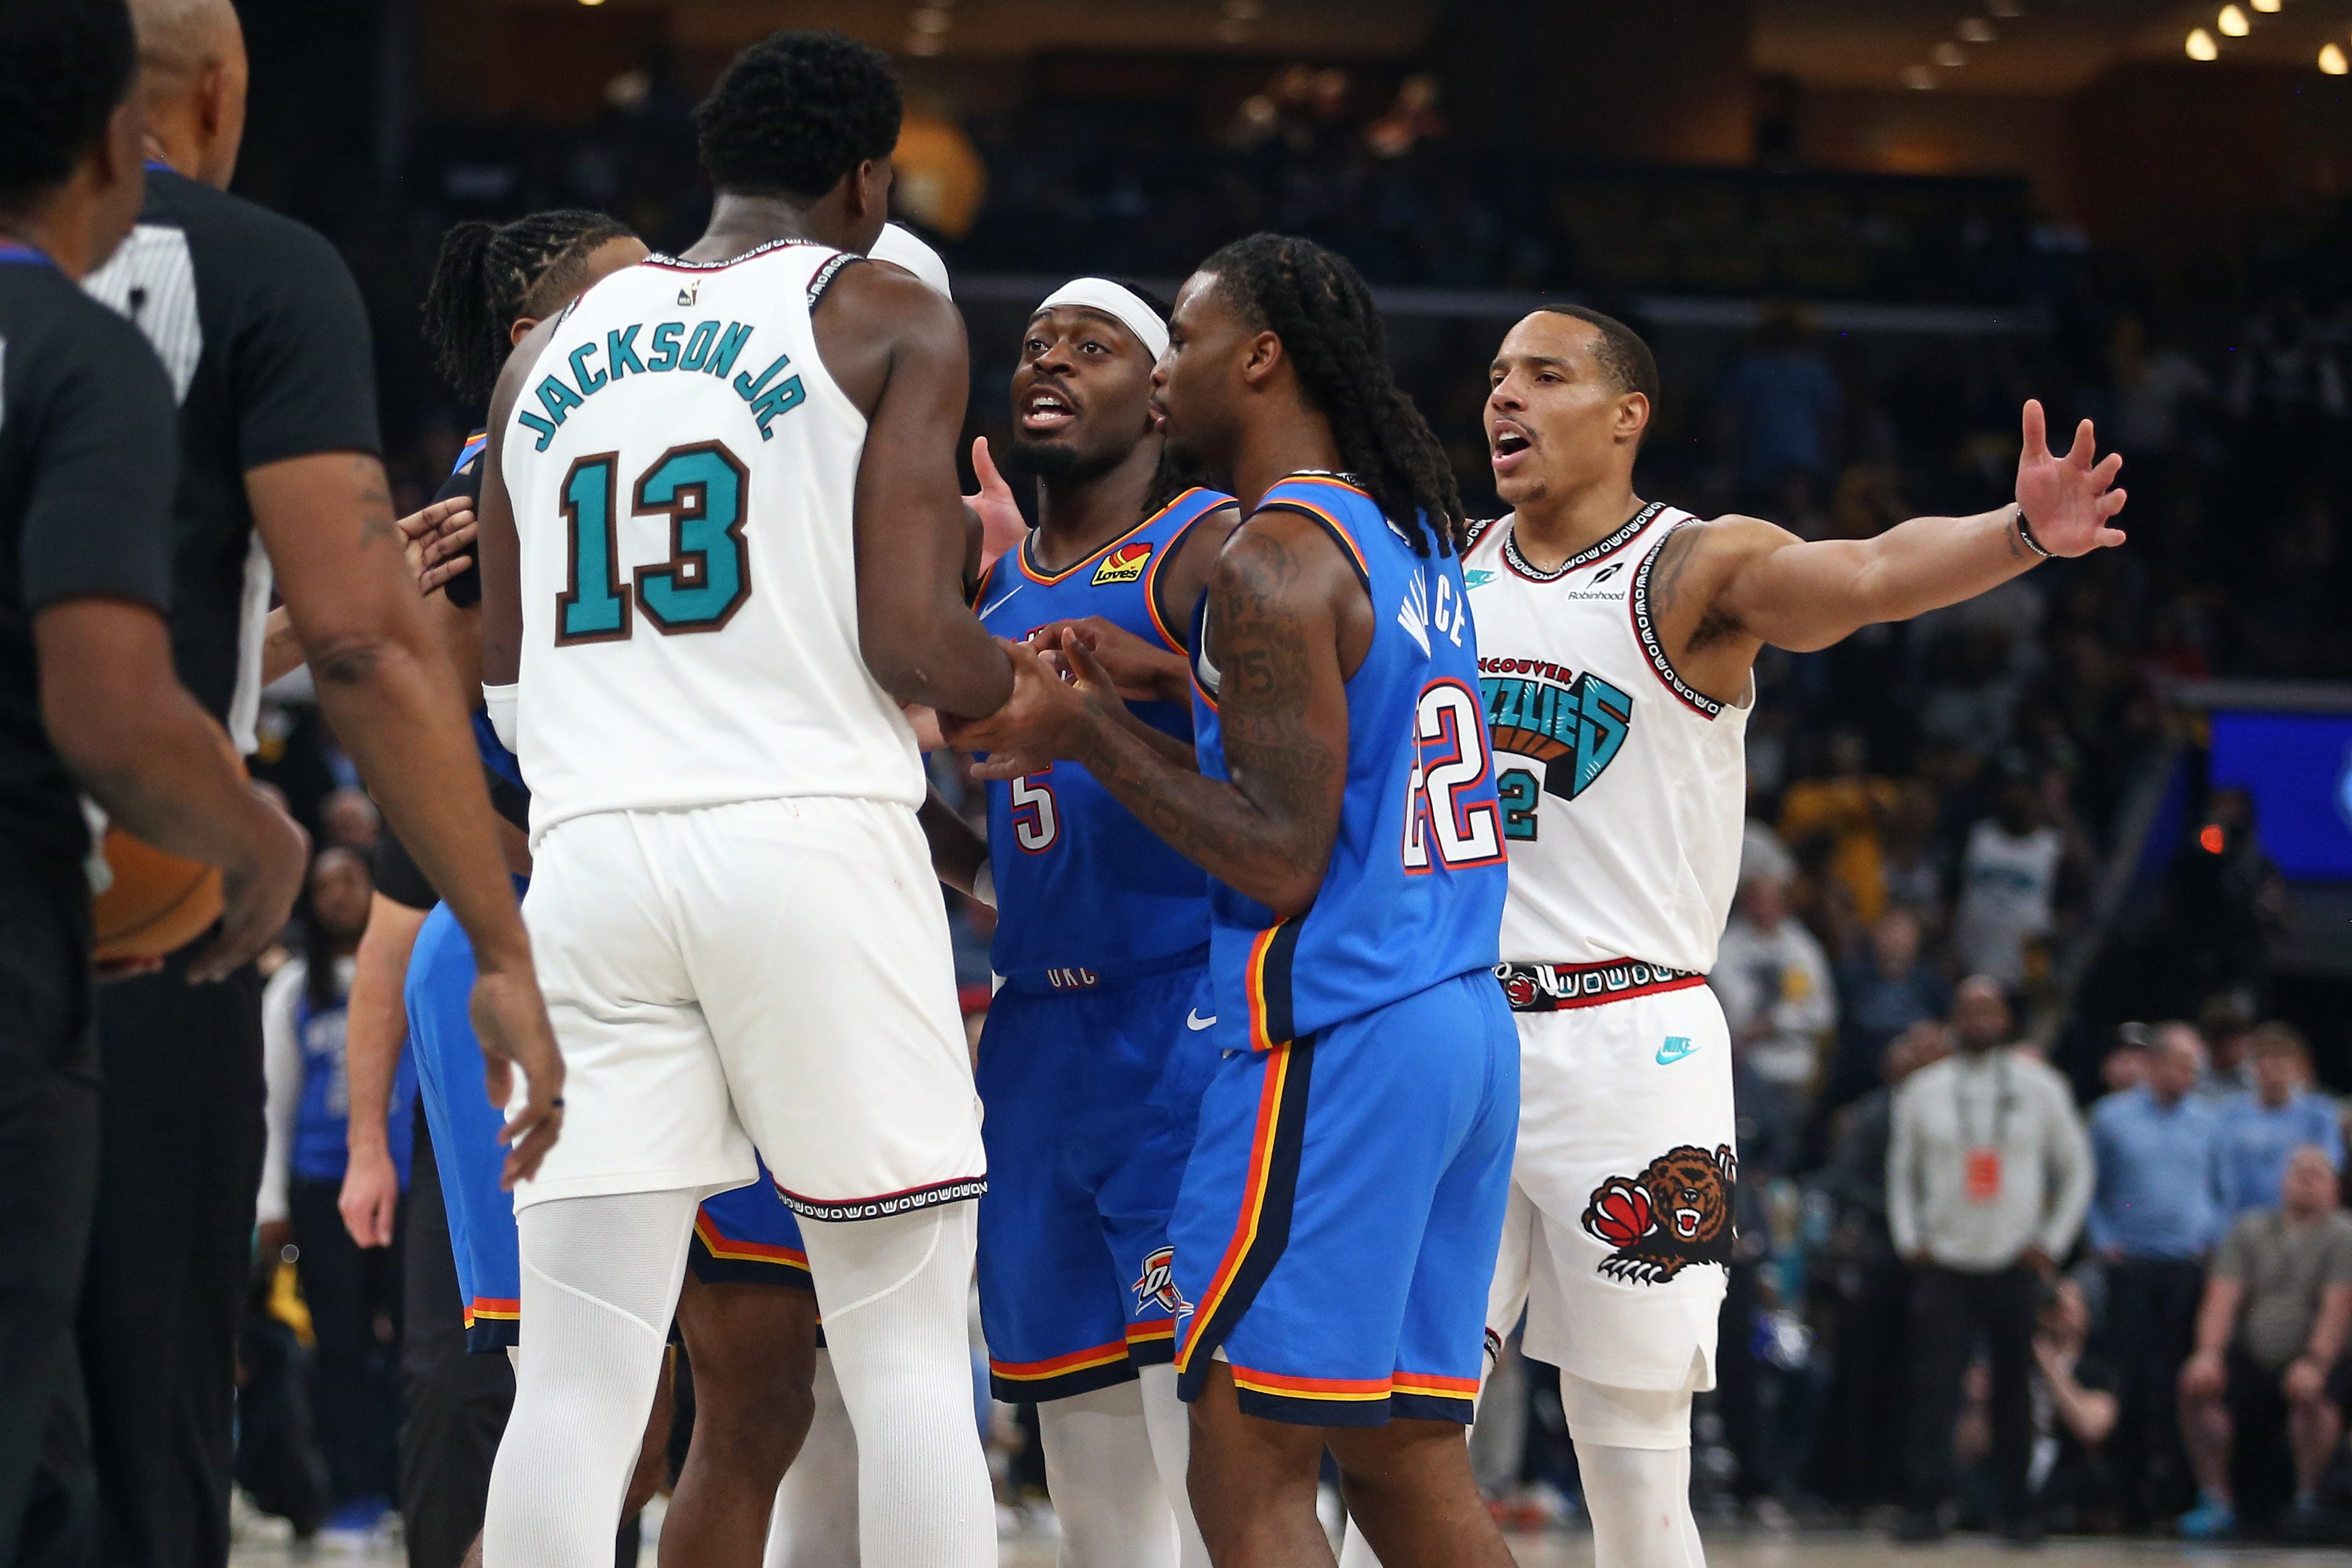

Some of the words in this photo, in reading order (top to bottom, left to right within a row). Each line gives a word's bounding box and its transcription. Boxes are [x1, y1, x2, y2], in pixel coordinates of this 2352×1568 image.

[518, 320, 754, 452] JACKSON
[554, 439, 752, 648] 13
[1567, 590, 1626, 601] Robinhood
[1477, 657, 1573, 684] NCOUVER
[1402, 676, 1508, 876] 22
[1479, 671, 1633, 801] ZZLIES
[1009, 765, 1059, 855] 5
[1497, 768, 1540, 842] 2
[1663, 1035, 1693, 1054] NIKE
